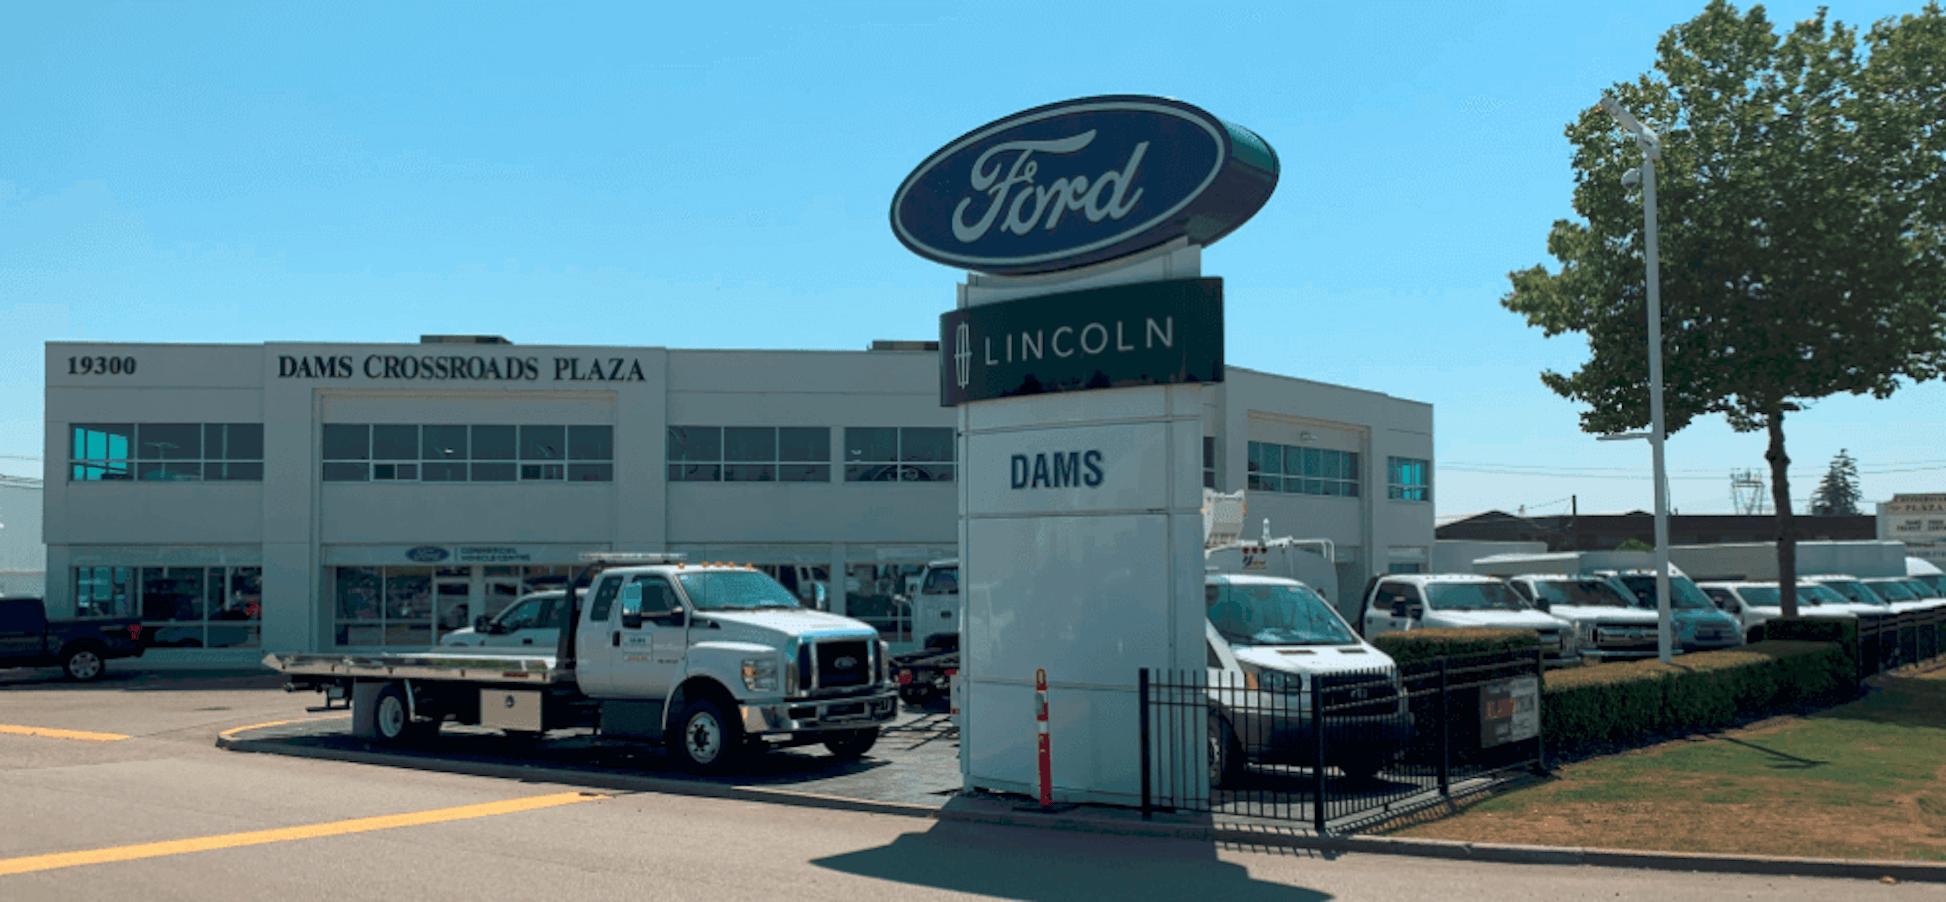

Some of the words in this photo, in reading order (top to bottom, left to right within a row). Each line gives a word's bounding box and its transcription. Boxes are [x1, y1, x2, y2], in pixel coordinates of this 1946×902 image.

[950, 128, 1150, 243] Ford
[984, 315, 1174, 367] LINCOLN
[66, 355, 137, 375] 19300
[277, 355, 353, 379] DAMS
[363, 354, 539, 380] CROSSROADS
[553, 357, 647, 381] PLAZA
[1010, 449, 1106, 489] DAMS
